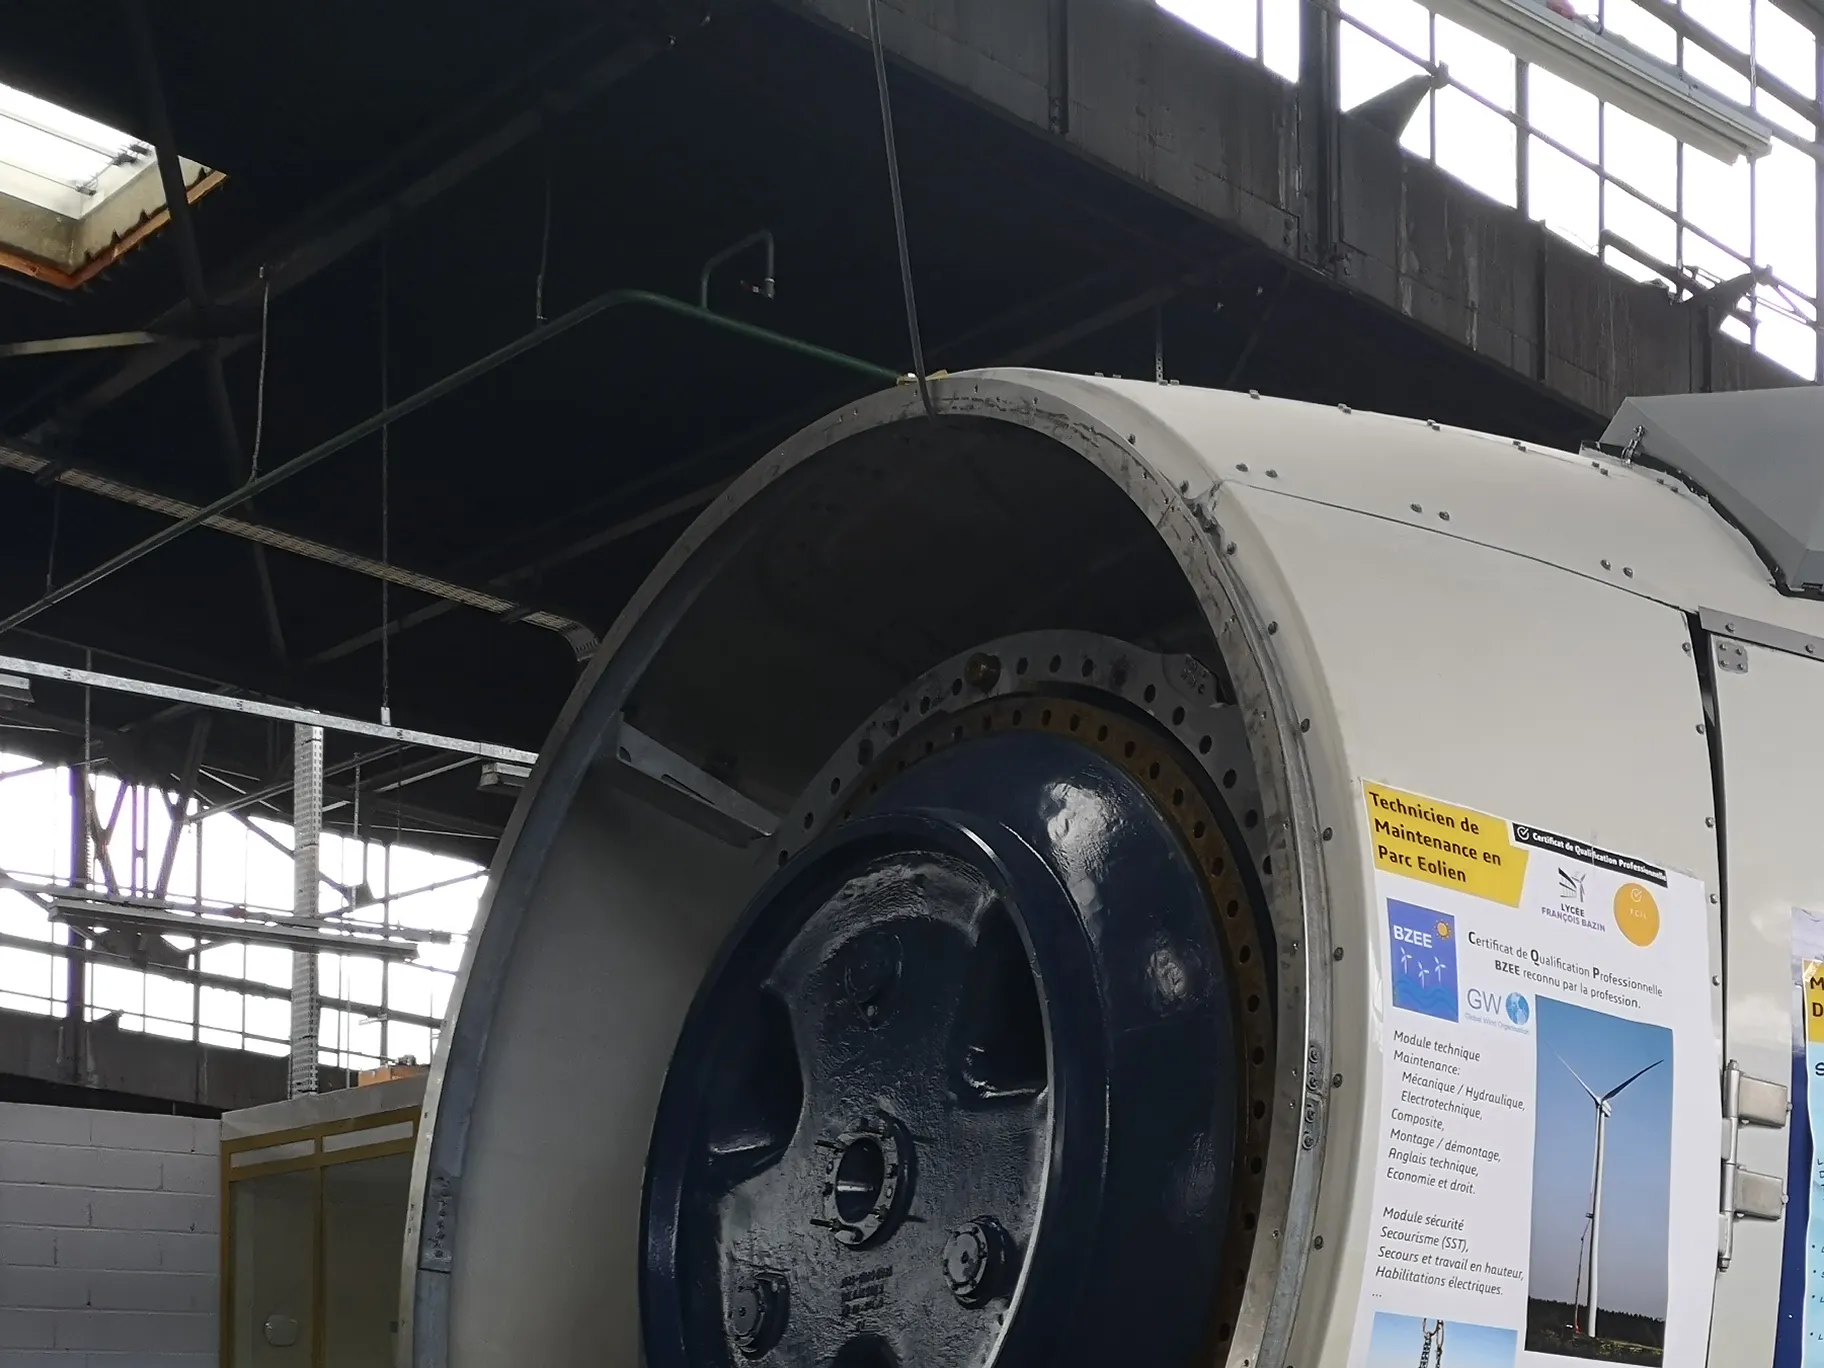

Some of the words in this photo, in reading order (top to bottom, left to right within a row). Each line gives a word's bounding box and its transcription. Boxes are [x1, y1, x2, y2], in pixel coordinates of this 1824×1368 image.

[1369, 792, 1455, 828] Technicien
[1461, 818, 1479, 834] de
[1375, 818, 1477, 860] Maintenance
[1484, 852, 1502, 866] en
[1532, 833, 1565, 849] Certificat
[1565, 842, 1573, 851] de
[1378, 845, 1412, 867] Parc
[1418, 856, 1466, 882] Eolien
[1541, 907, 1580, 927] FRANÇOIS
[1582, 917, 1605, 932] BAZIN
[1561, 903, 1585, 917] LYCÉE
[1393, 925, 1432, 948] BZEE
[1468, 932, 1513, 955] Certificat
[1517, 948, 1528, 960] de
[1531, 950, 1590, 977] Qualification
[1593, 968, 1663, 997] Professionnelle
[1495, 960, 1520, 976] BZEE
[1523, 970, 1560, 987] reconnu
[1563, 980, 1577, 992] par
[1581, 983, 1588, 995] la
[1591, 988, 1641, 1009] profession.
[1394, 1030, 1431, 1049] Module
[1434, 1041, 1481, 1062] technique
[1394, 1050, 1460, 1076] Maintenance:
[1401, 1091, 1483, 1120] Electrotechnique,
[1402, 1072, 1455, 1094] Mécanique
[1465, 1086, 1525, 1111] Hydraulique,
[1392, 1109, 1445, 1132] Composite,
[1390, 1129, 1435, 1149] Montage
[1445, 1140, 1501, 1162] démontage,
[1388, 1148, 1426, 1165] Anglais
[1430, 1157, 1479, 1177] technique,
[1387, 1168, 1436, 1186] Economie
[1438, 1178, 1447, 1189] et
[1450, 1179, 1476, 1195] droit.
[1383, 1207, 1423, 1224] Module
[1425, 1214, 1464, 1231] sécurité
[1381, 1227, 1439, 1246] Secourisme
[1442, 1236, 1468, 1253] (SST),
[1378, 1246, 1419, 1263] Secours
[1422, 1255, 1432, 1264] et
[1435, 1256, 1468, 1271] travail
[1470, 1263, 1482, 1272] en
[1485, 1262, 1524, 1282] hauteur,
[1375, 1266, 1446, 1287] Habilitations
[1449, 1276, 1503, 1295] électriques.
